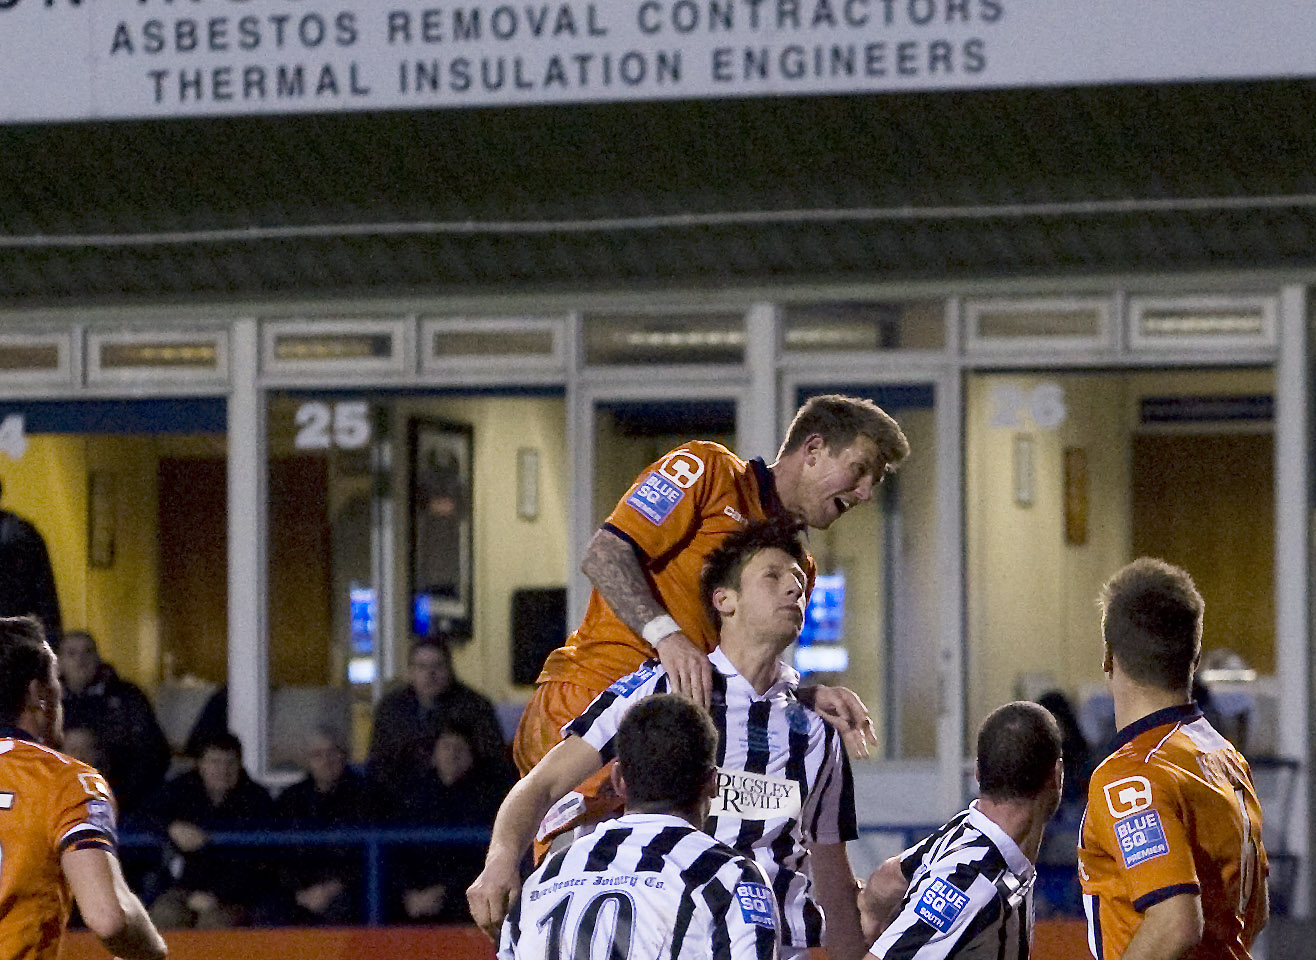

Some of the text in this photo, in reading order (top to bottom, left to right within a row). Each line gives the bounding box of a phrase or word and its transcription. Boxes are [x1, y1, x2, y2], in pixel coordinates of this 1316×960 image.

[110, 0, 1003, 56] ASBESTOS REMOVAL CONTRACTORS
[148, 38, 988, 102] THERMAL INSULATION ENGINEERS
[991, 384, 1067, 431] 26
[295, 402, 370, 448] 25
[636, 485, 661, 504] SQ
[645, 475, 680, 503] BLUE
[716, 772, 794, 798] PUGSLEY
[1117, 813, 1158, 839] BLUE
[1121, 830, 1147, 852] SQ
[1126, 843, 1166, 865] PREMIER
[736, 885, 768, 900] BLU
[740, 897, 767, 913] SQ
[922, 889, 947, 914] SQ
[930, 880, 967, 910] BLUE
[919, 906, 945, 928] SOUTH
